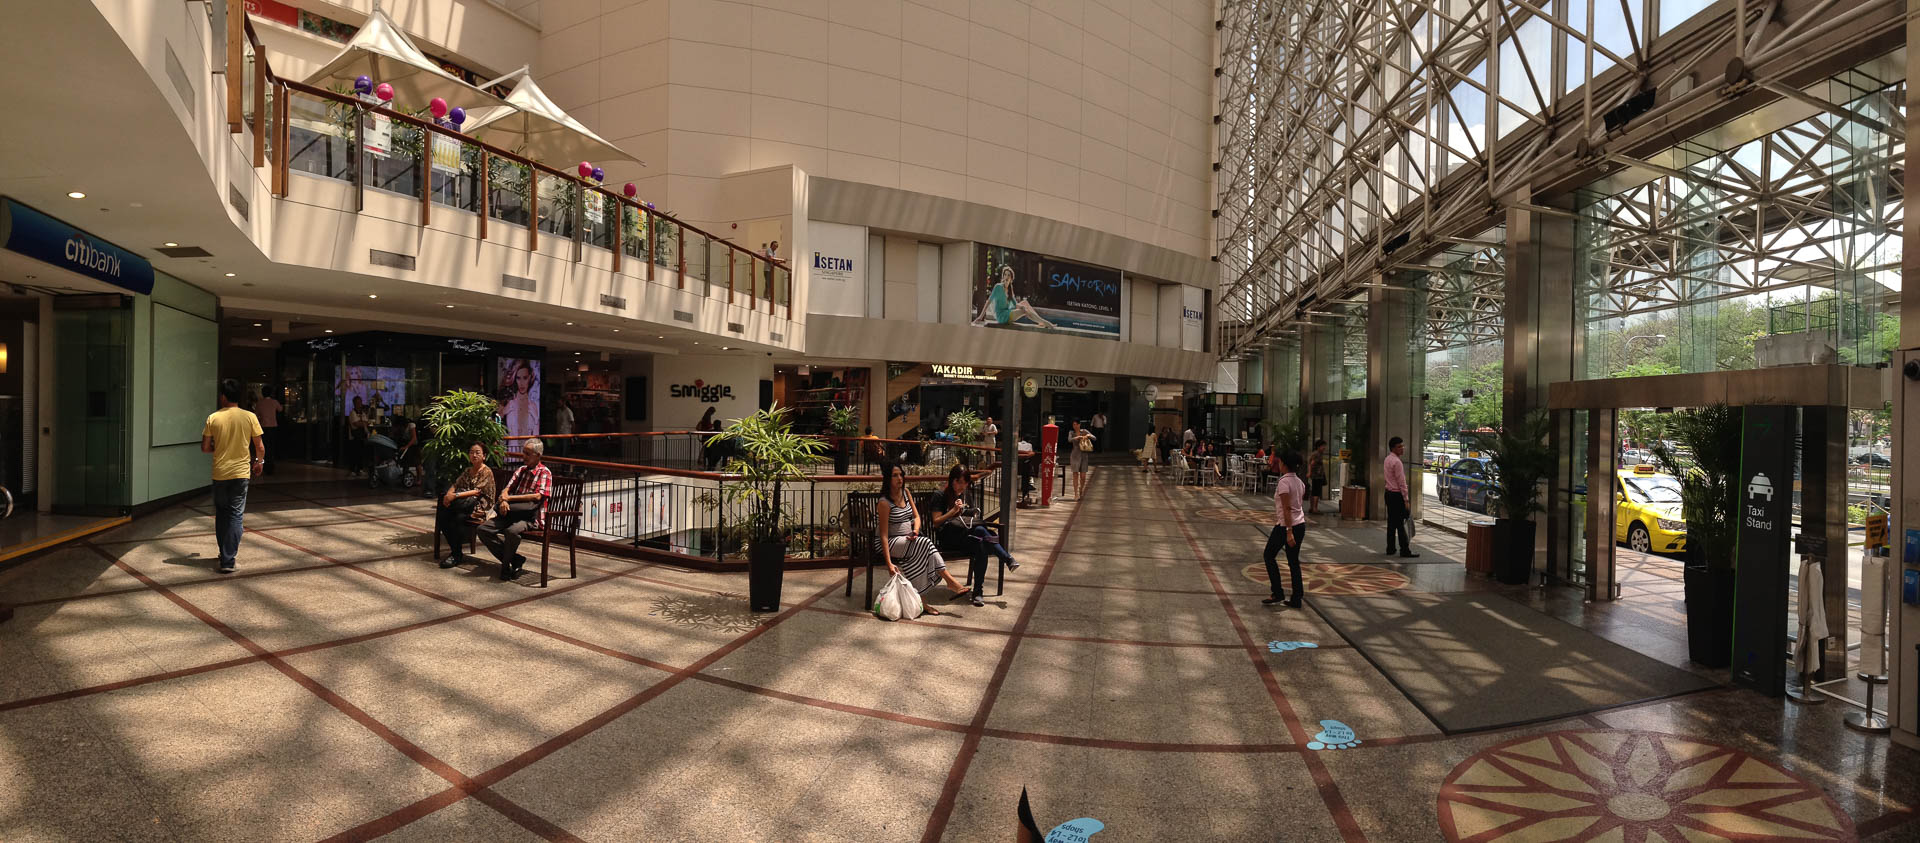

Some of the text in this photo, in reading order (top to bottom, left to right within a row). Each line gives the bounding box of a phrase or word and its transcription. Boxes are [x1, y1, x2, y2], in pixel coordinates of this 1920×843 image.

[65, 238, 121, 277] citibank
[814, 252, 853, 271] ISETAN
[1048, 272, 1117, 296] SANTORINI
[931, 364, 973, 375] YAKADIR
[1043, 374, 1074, 388] HSBC
[1746, 504, 1765, 517] Taxi
[1746, 516, 1772, 530] Stand
[1061, 824, 1084, 834] shops
